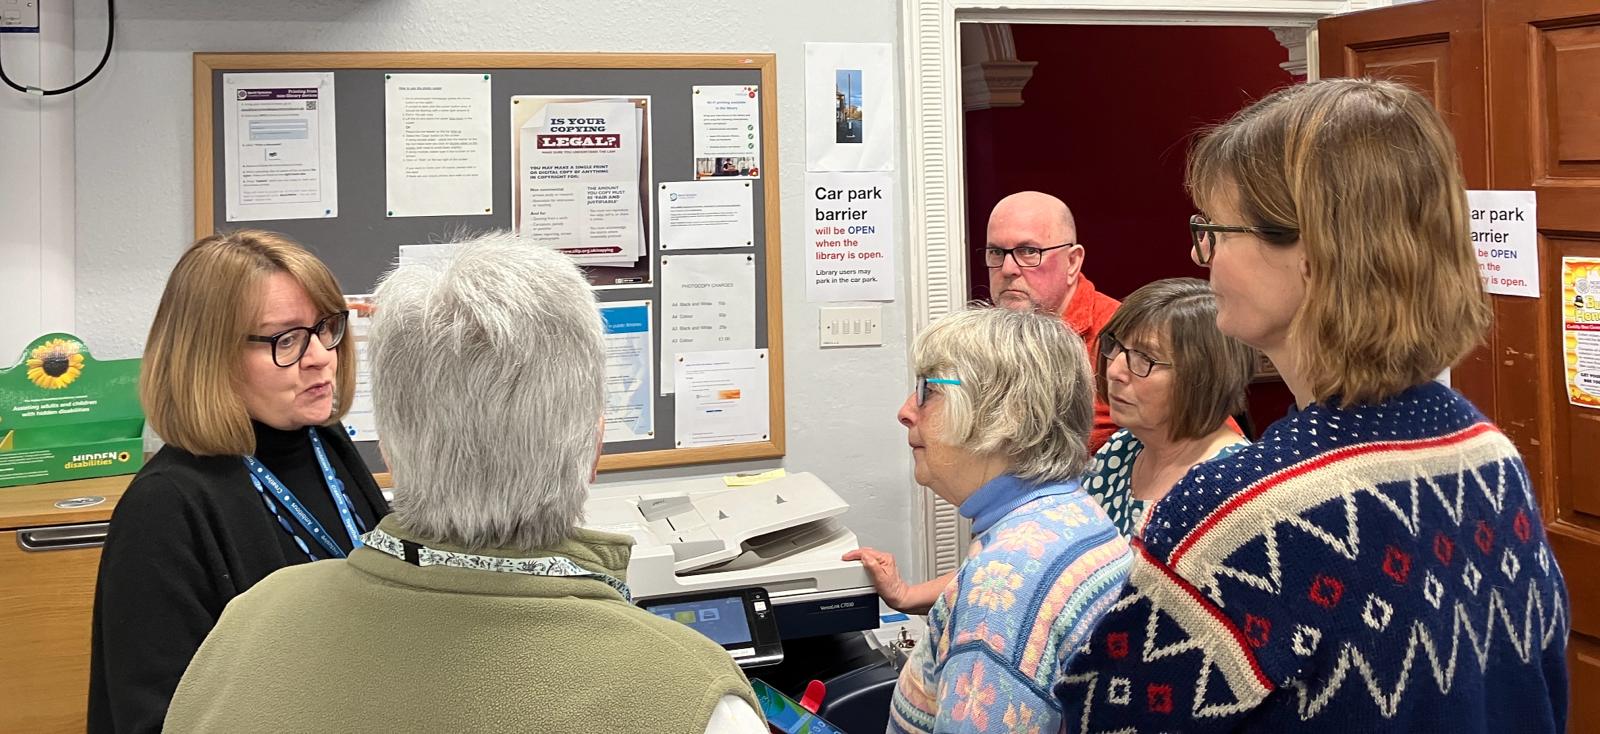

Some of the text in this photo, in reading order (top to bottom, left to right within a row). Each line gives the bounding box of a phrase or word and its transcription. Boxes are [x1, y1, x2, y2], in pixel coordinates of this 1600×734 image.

[542, 137, 617, 148] LEGAL?
[816, 186, 882, 202] Car park
[816, 207, 867, 220] barrier
[1472, 207, 1524, 223] ar park
[848, 226, 875, 234] OPEN
[1471, 229, 1509, 243] arrier
[816, 252, 845, 260] library
[858, 251, 884, 260] open.
[1478, 248, 1517, 258] be OPEN
[1487, 263, 1500, 271] the
[1491, 276, 1498, 284] is
[1501, 278, 1527, 287] open.
[73, 452, 117, 462] HIDDEN
[64, 459, 112, 469] disabilities
[265, 474, 283, 494] Creative
[291, 502, 312, 525] Ambitious
